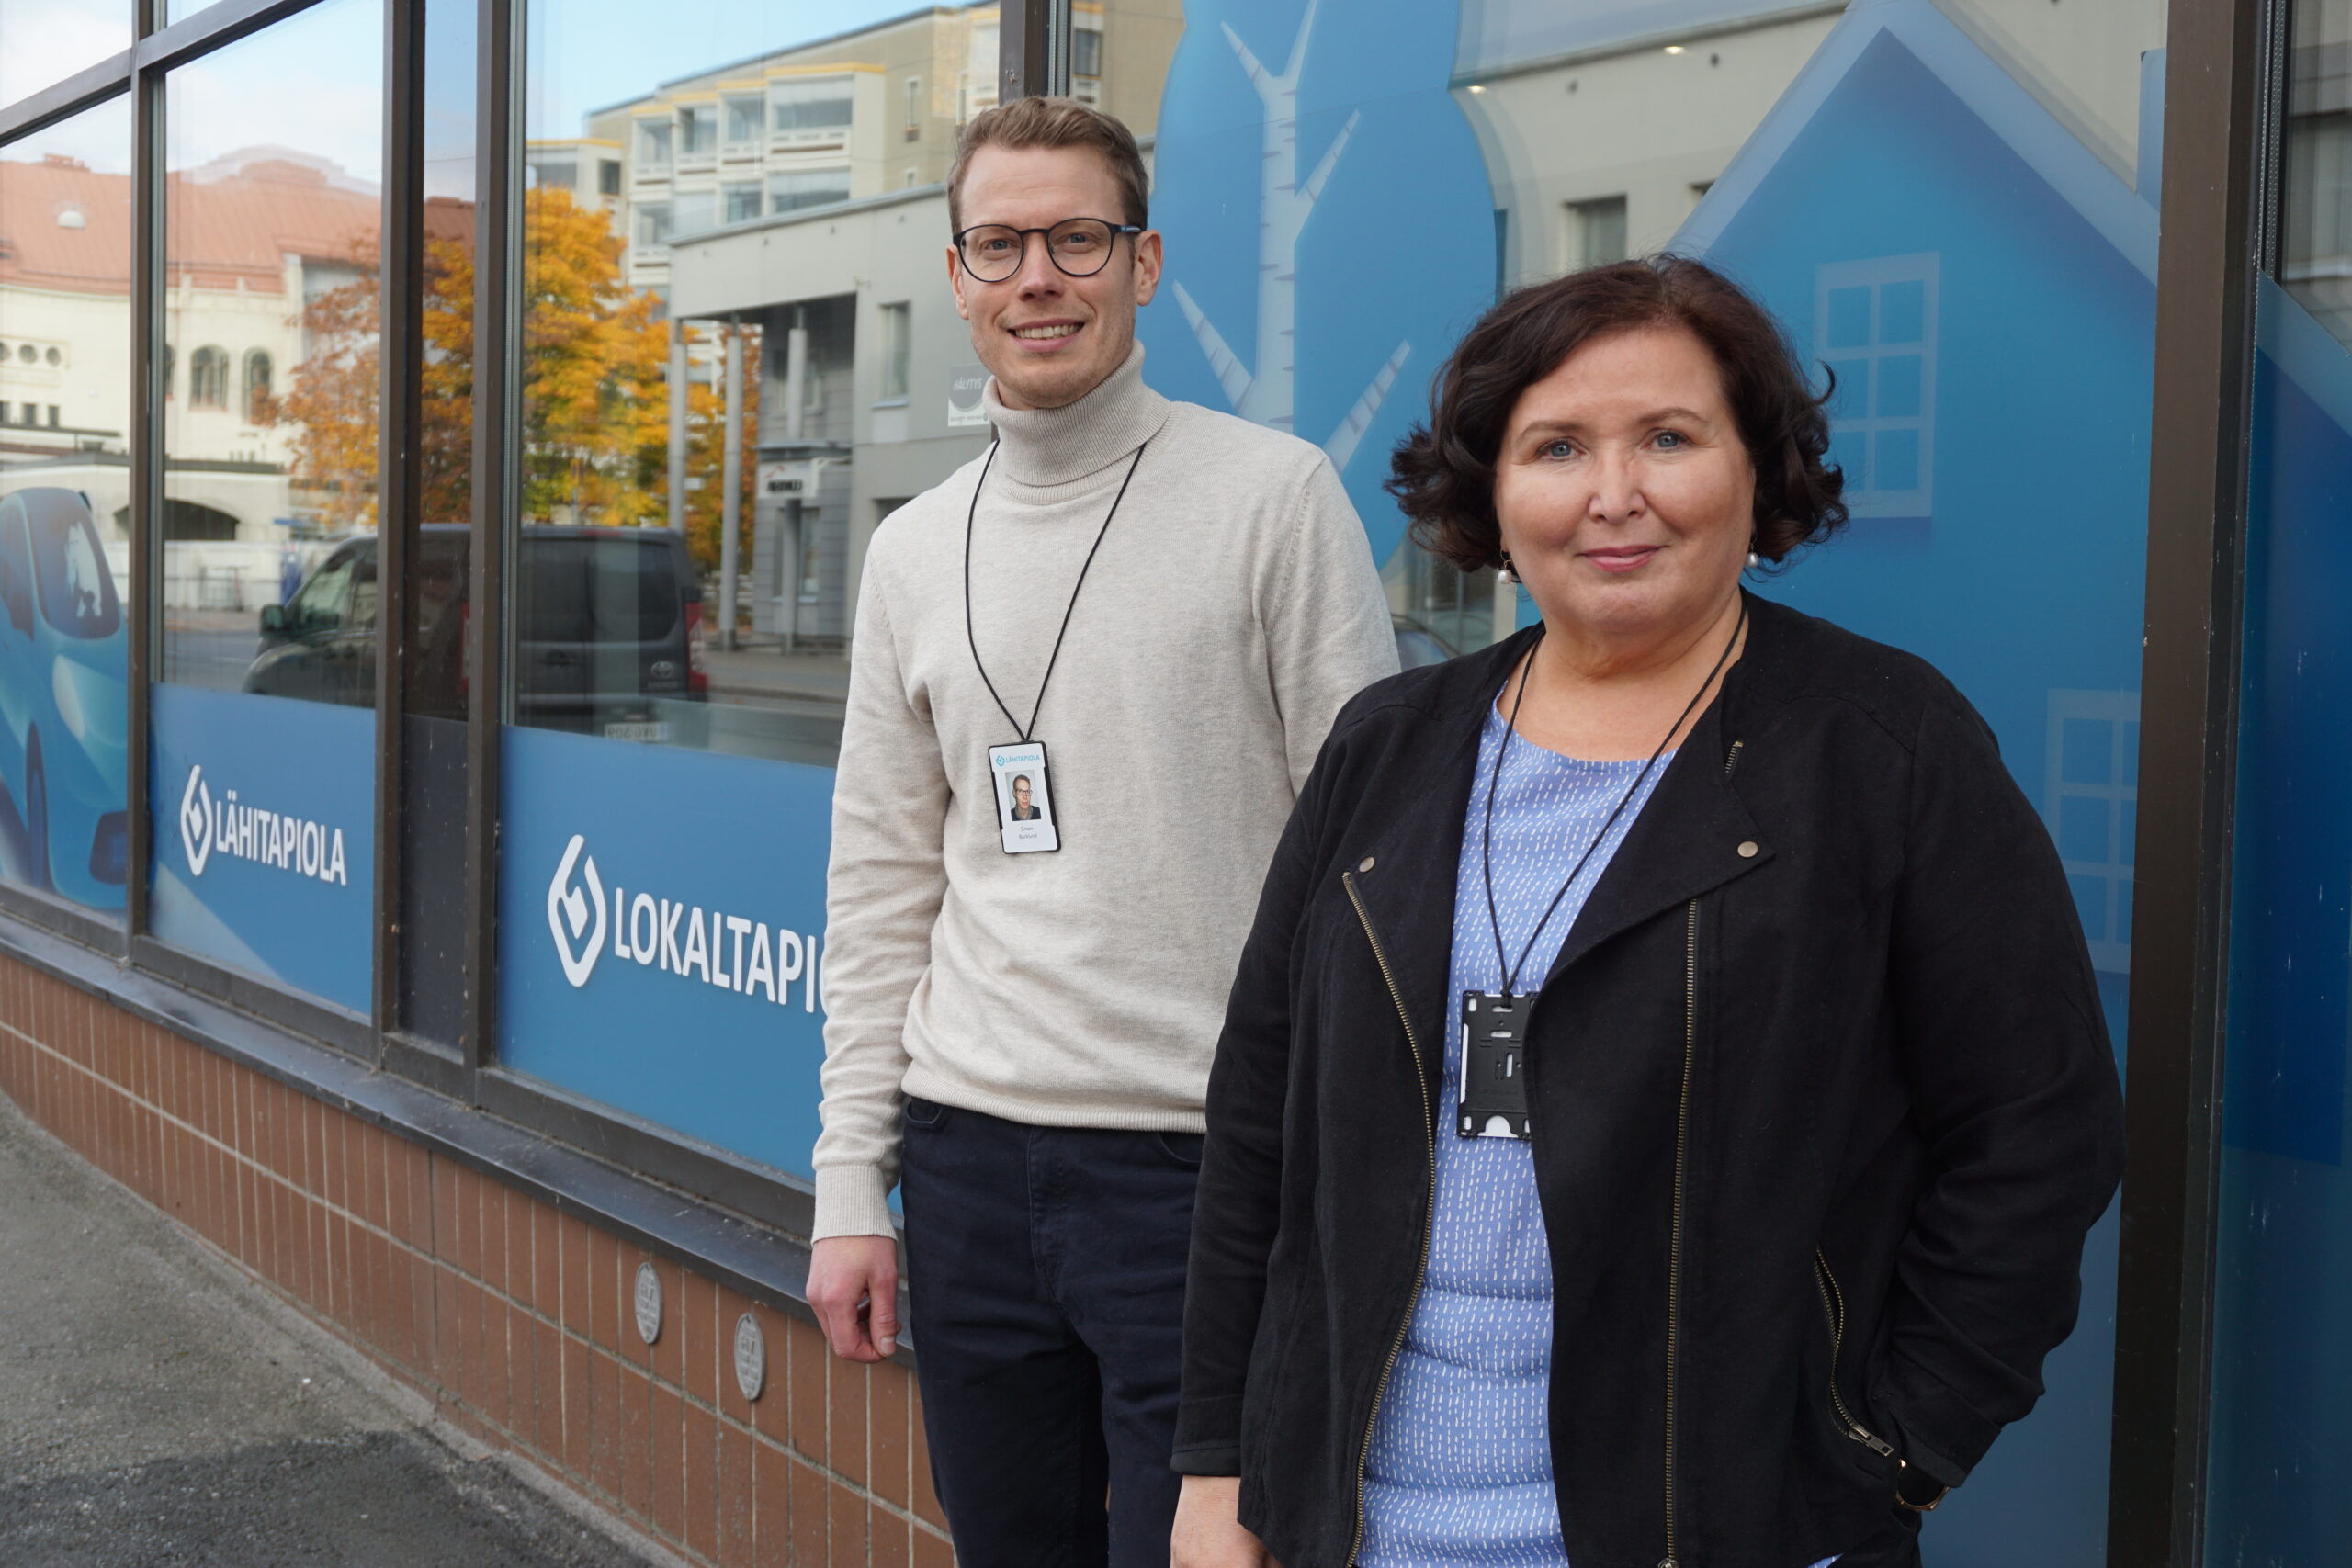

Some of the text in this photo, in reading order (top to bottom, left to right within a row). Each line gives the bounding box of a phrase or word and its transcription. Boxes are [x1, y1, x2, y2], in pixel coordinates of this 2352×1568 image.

[1006, 754, 1040, 763] LÄHITAPIOLA
[216, 789, 346, 886] LÄHITAPIOLA
[615, 887, 828, 1017] LOKALTAPI
